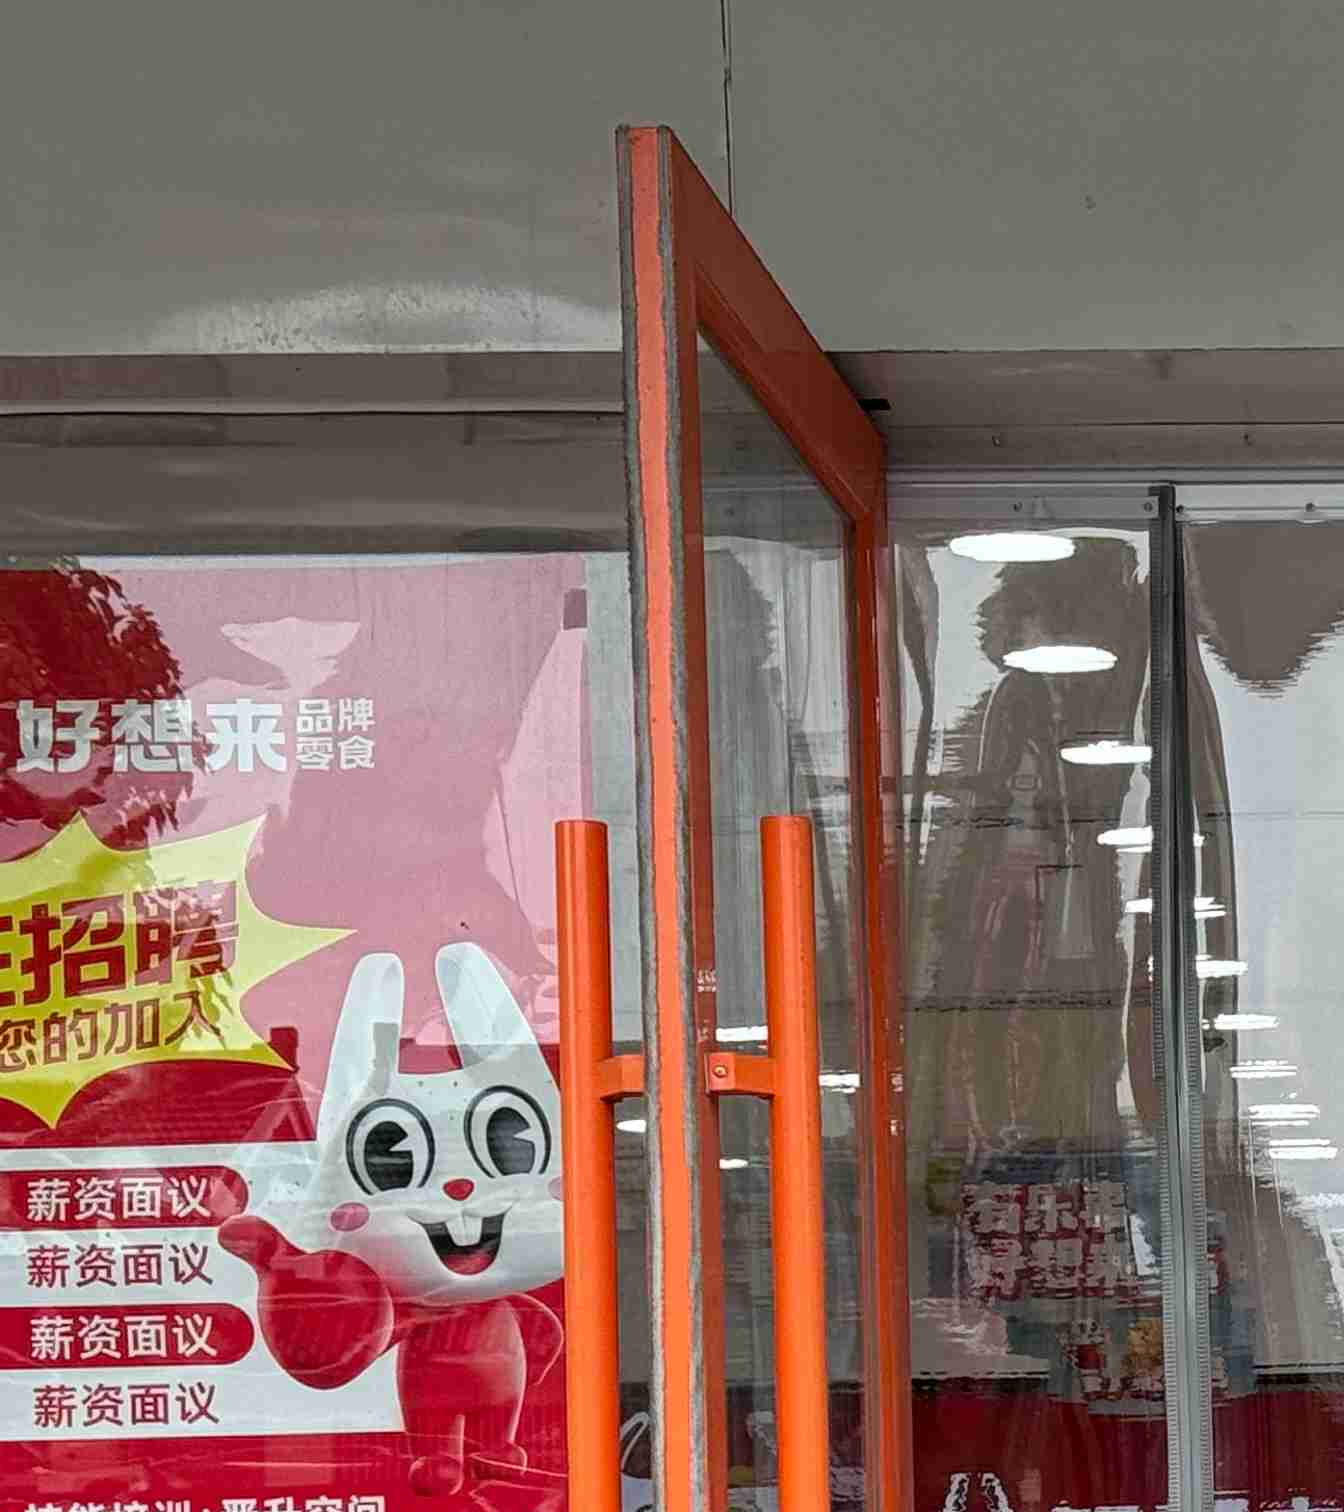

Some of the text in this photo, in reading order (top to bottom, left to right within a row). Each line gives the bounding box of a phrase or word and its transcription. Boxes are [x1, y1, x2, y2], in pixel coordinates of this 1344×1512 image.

[16, 699, 287, 773] 好想来
[297, 699, 374, 732] 品牌
[297, 736, 374, 769] 零食
[26, 1177, 210, 1222] 薪资面议
[26, 1242, 213, 1289] 薪资面议
[30, 1313, 216, 1360] 薪资面议
[33, 1382, 219, 1428] 薪资面议
